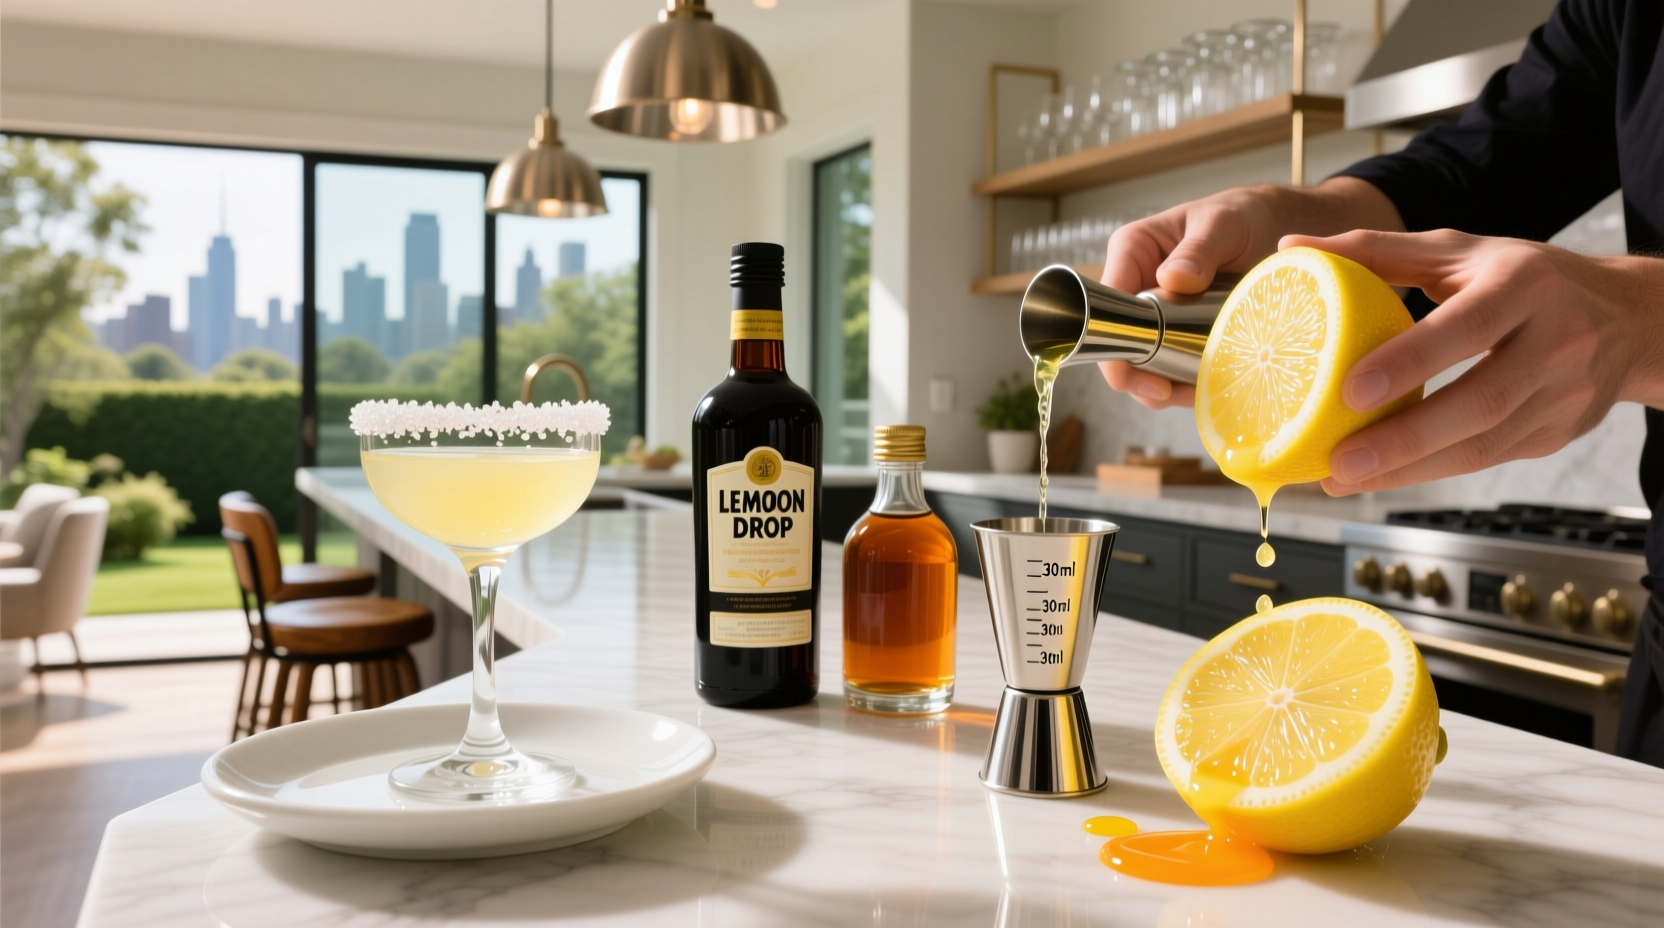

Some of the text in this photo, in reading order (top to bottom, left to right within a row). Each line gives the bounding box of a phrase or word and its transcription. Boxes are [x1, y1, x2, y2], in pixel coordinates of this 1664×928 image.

[719, 489, 805, 513] LEMOON
[733, 516, 793, 539] DROP
[1042, 561, 1075, 577] 30ml
